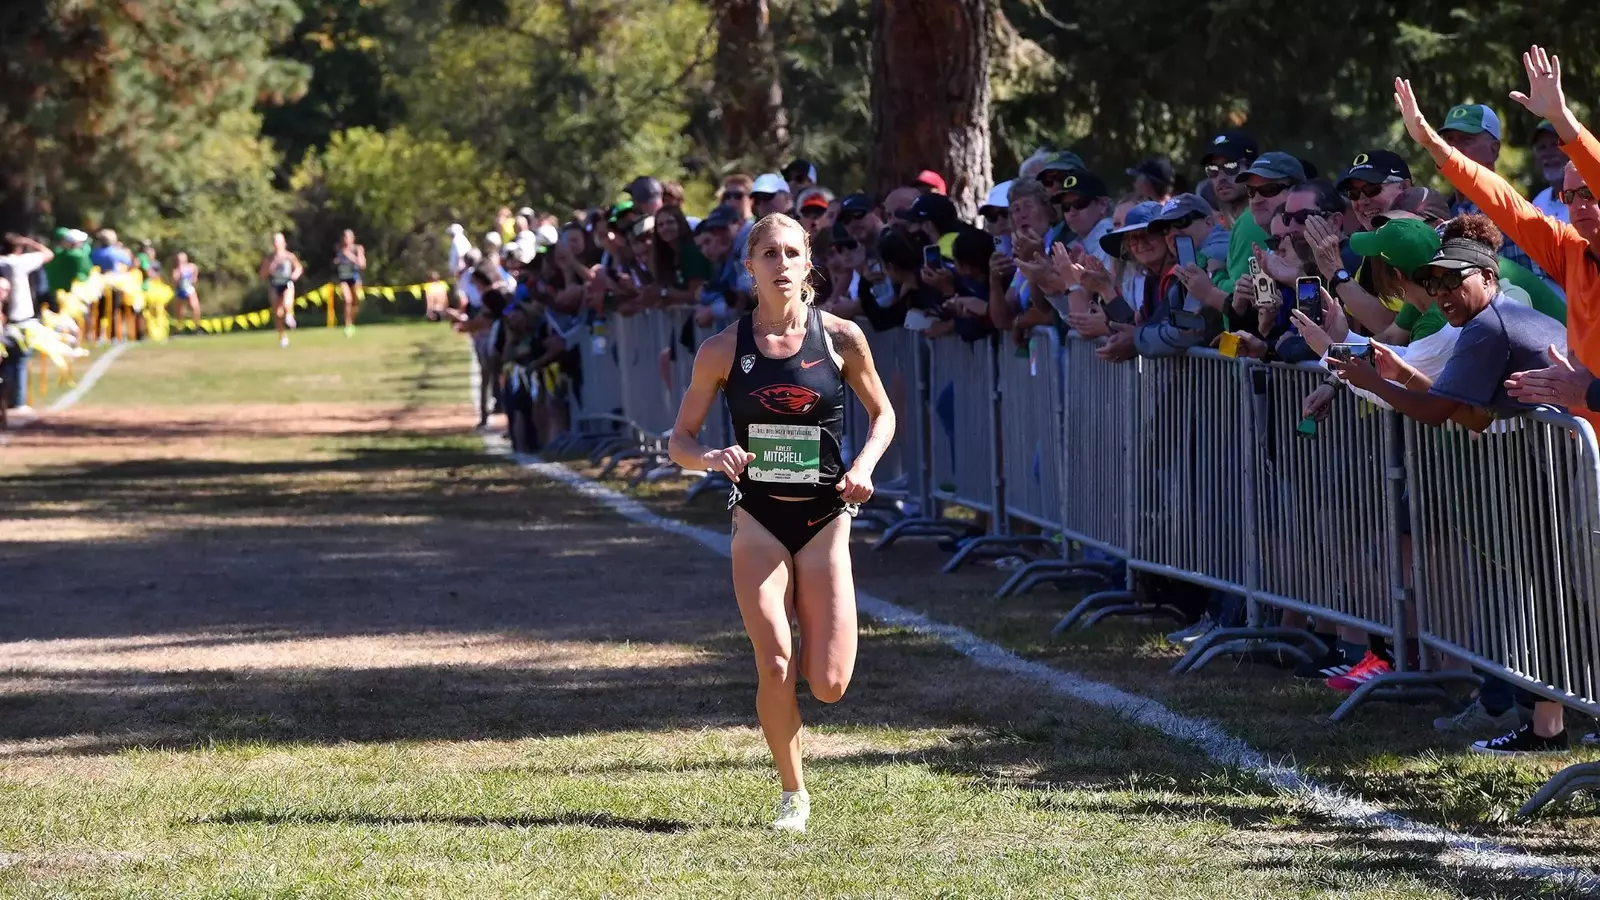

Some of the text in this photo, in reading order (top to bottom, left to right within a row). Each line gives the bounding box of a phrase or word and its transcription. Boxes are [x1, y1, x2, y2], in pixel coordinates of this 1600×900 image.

[1352, 153, 1369, 166] O
[1063, 175, 1078, 189] O
[763, 450, 804, 464] MITCHELL
